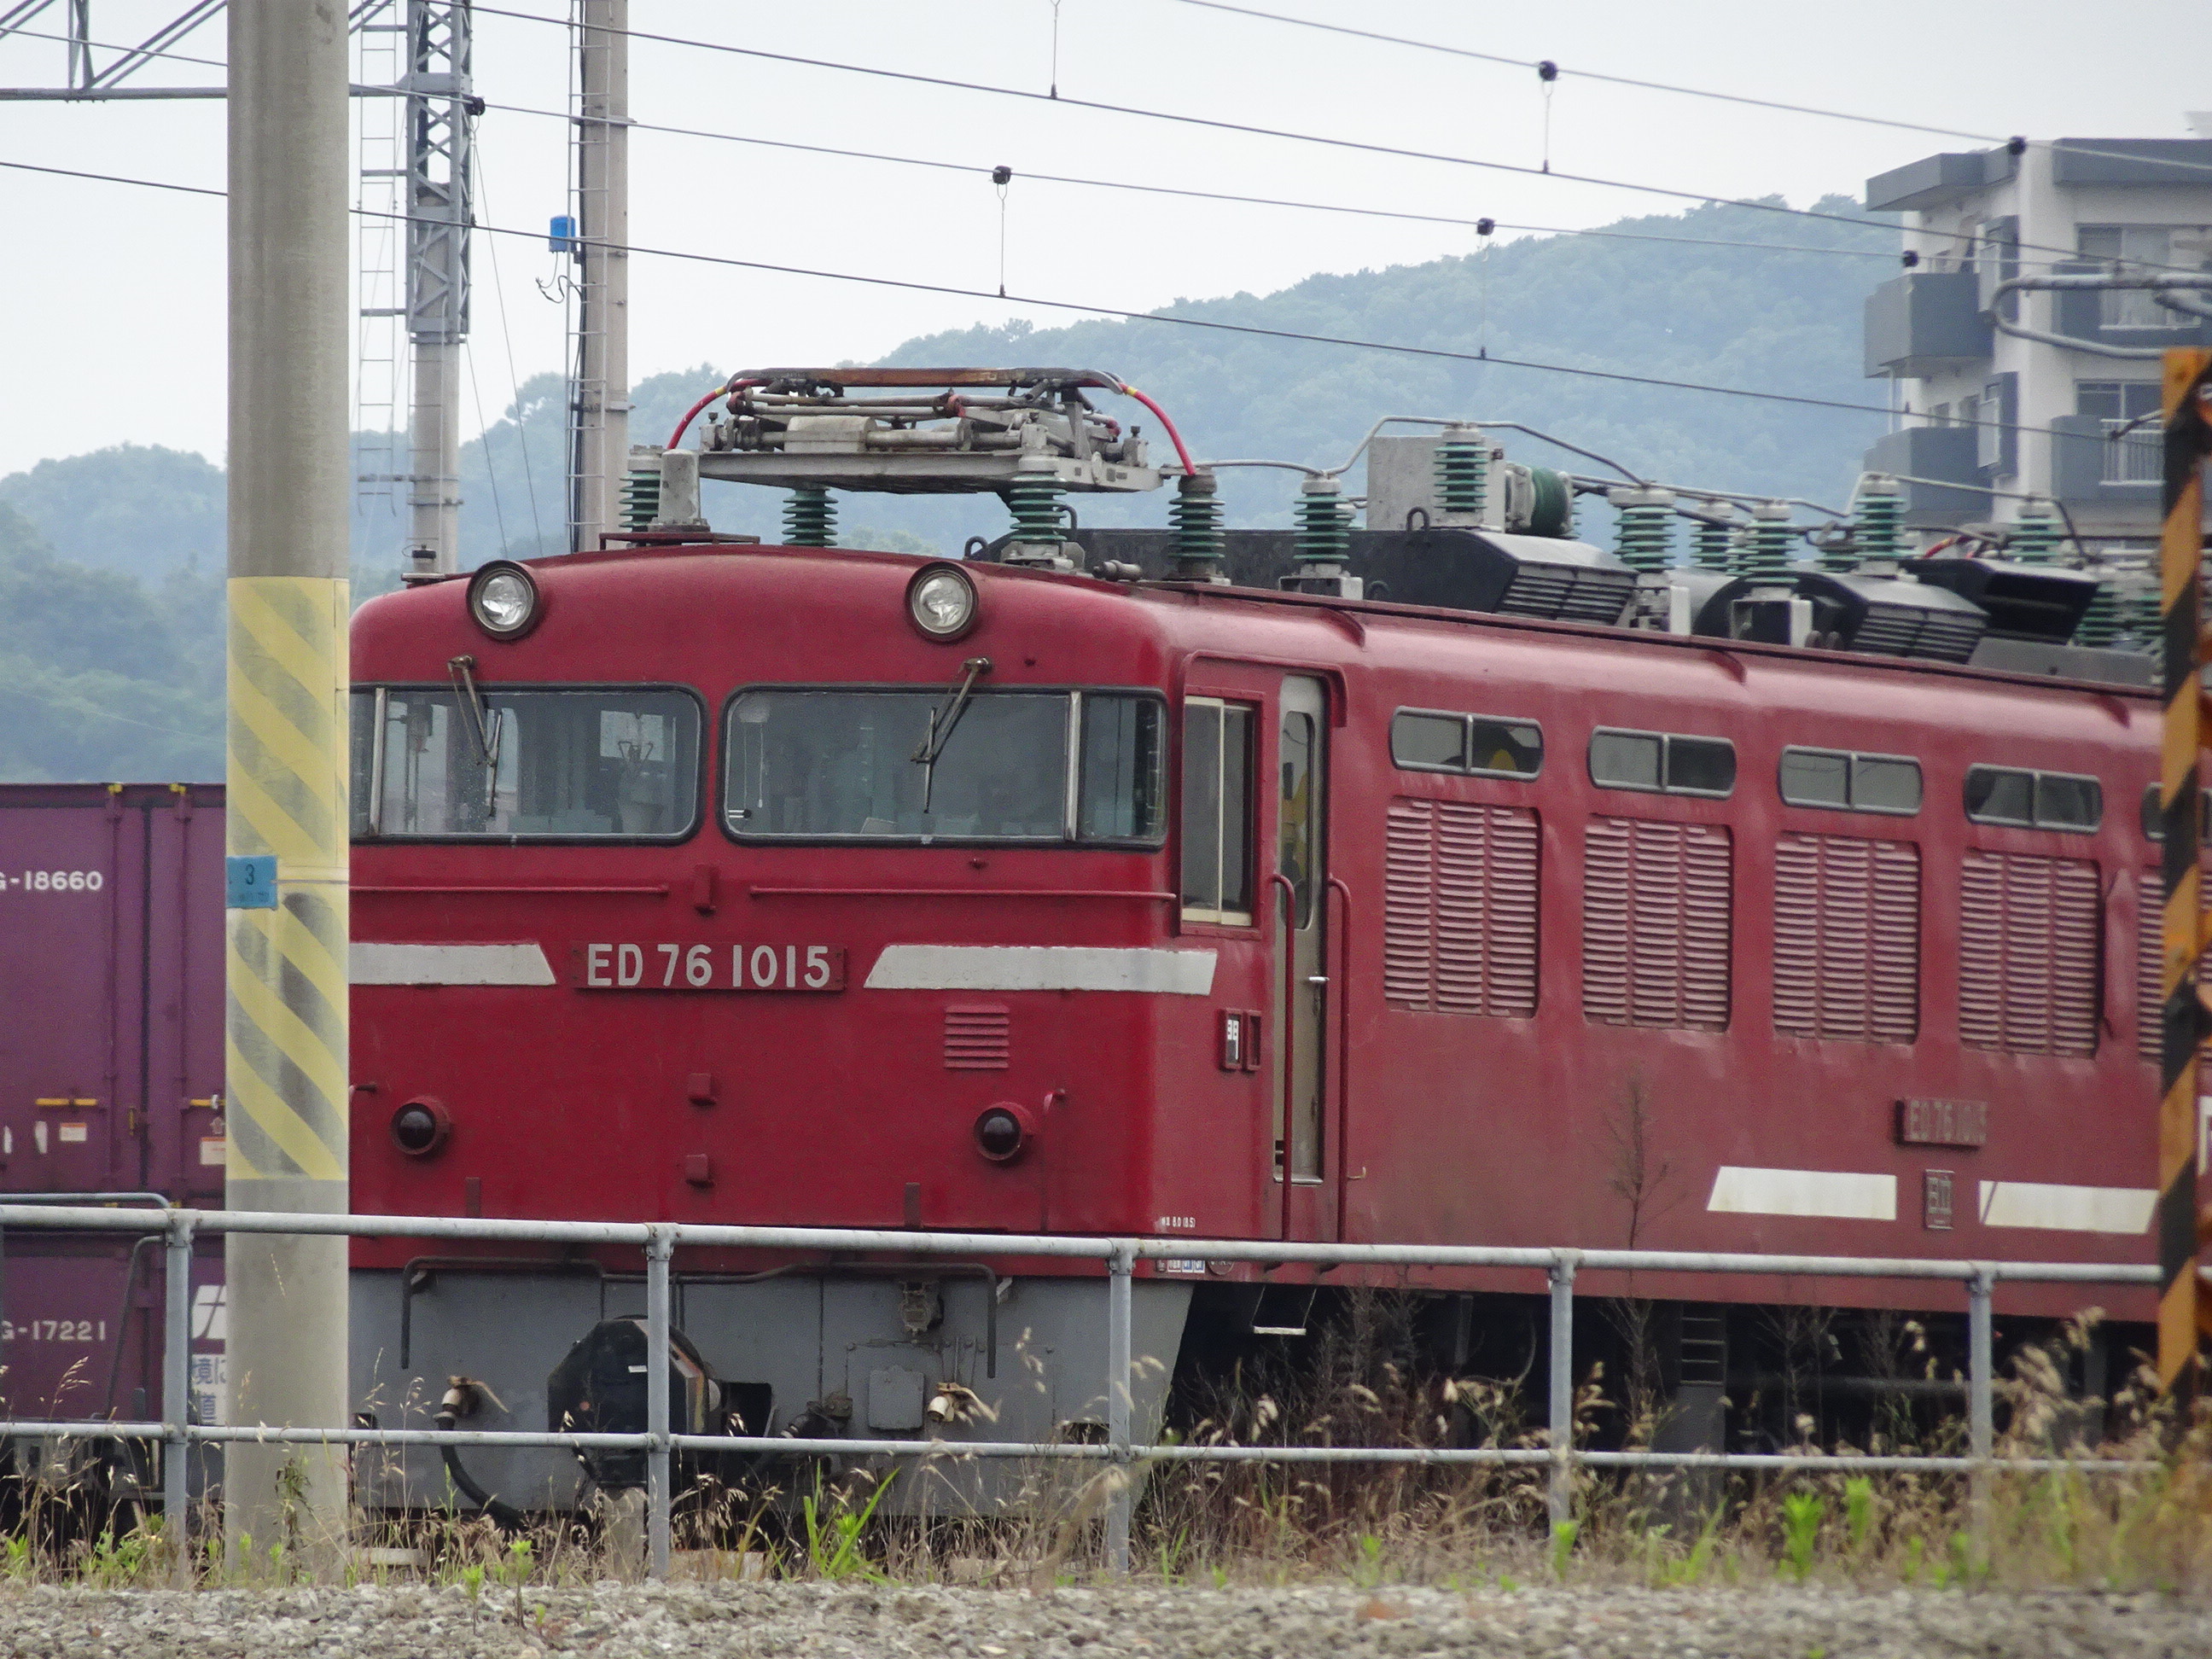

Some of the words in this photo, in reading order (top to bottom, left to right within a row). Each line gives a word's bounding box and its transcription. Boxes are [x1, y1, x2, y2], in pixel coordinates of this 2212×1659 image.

[244, 864, 255, 886] 3
[587, 943, 643, 987] ED
[657, 943, 713, 987] 76
[732, 944, 831, 988] 1015
